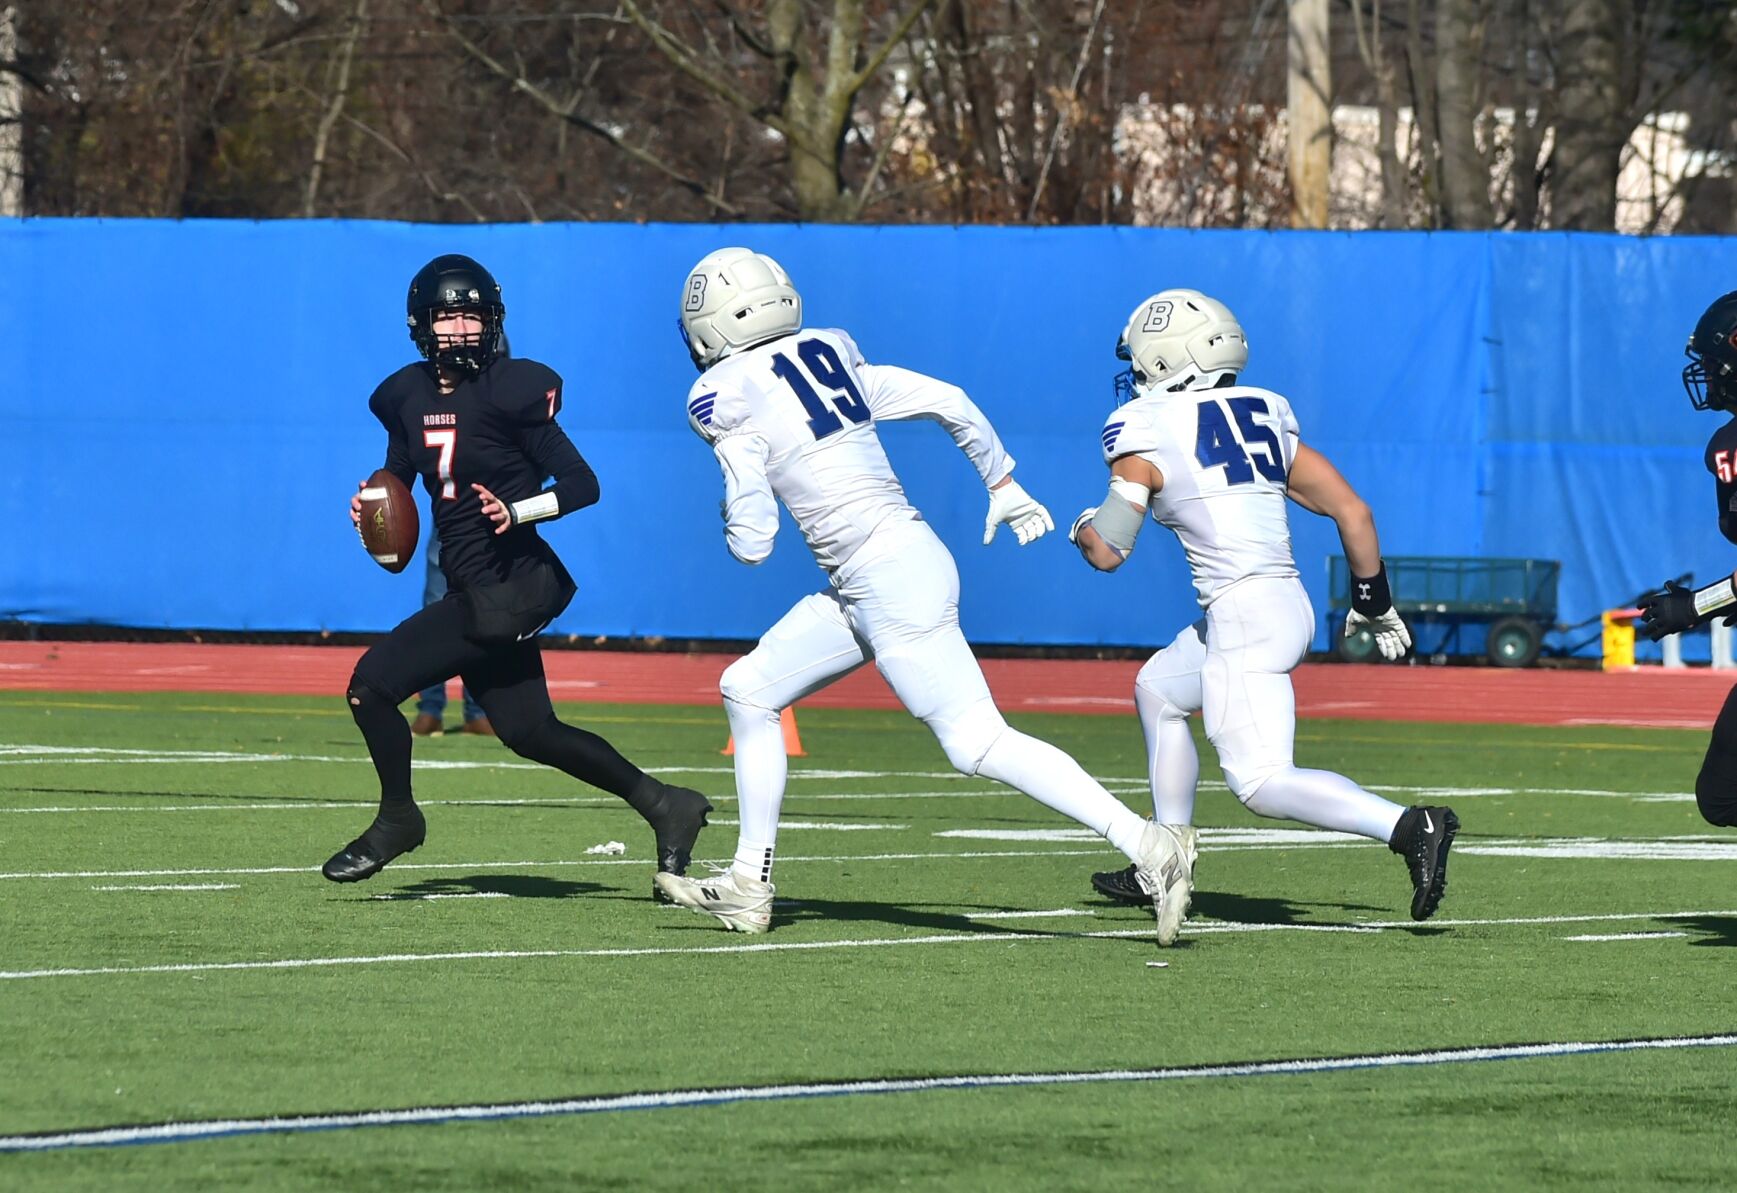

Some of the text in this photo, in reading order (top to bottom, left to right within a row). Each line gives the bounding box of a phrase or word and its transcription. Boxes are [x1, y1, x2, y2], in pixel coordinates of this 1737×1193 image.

[685, 274, 708, 312] B
[1142, 301, 1174, 333] B
[545, 387, 557, 421] 7
[770, 337, 871, 441] 19
[423, 413, 457, 426] HORSES
[1194, 395, 1287, 487] 45
[423, 428, 458, 501] 7
[700, 887, 721, 901] N
